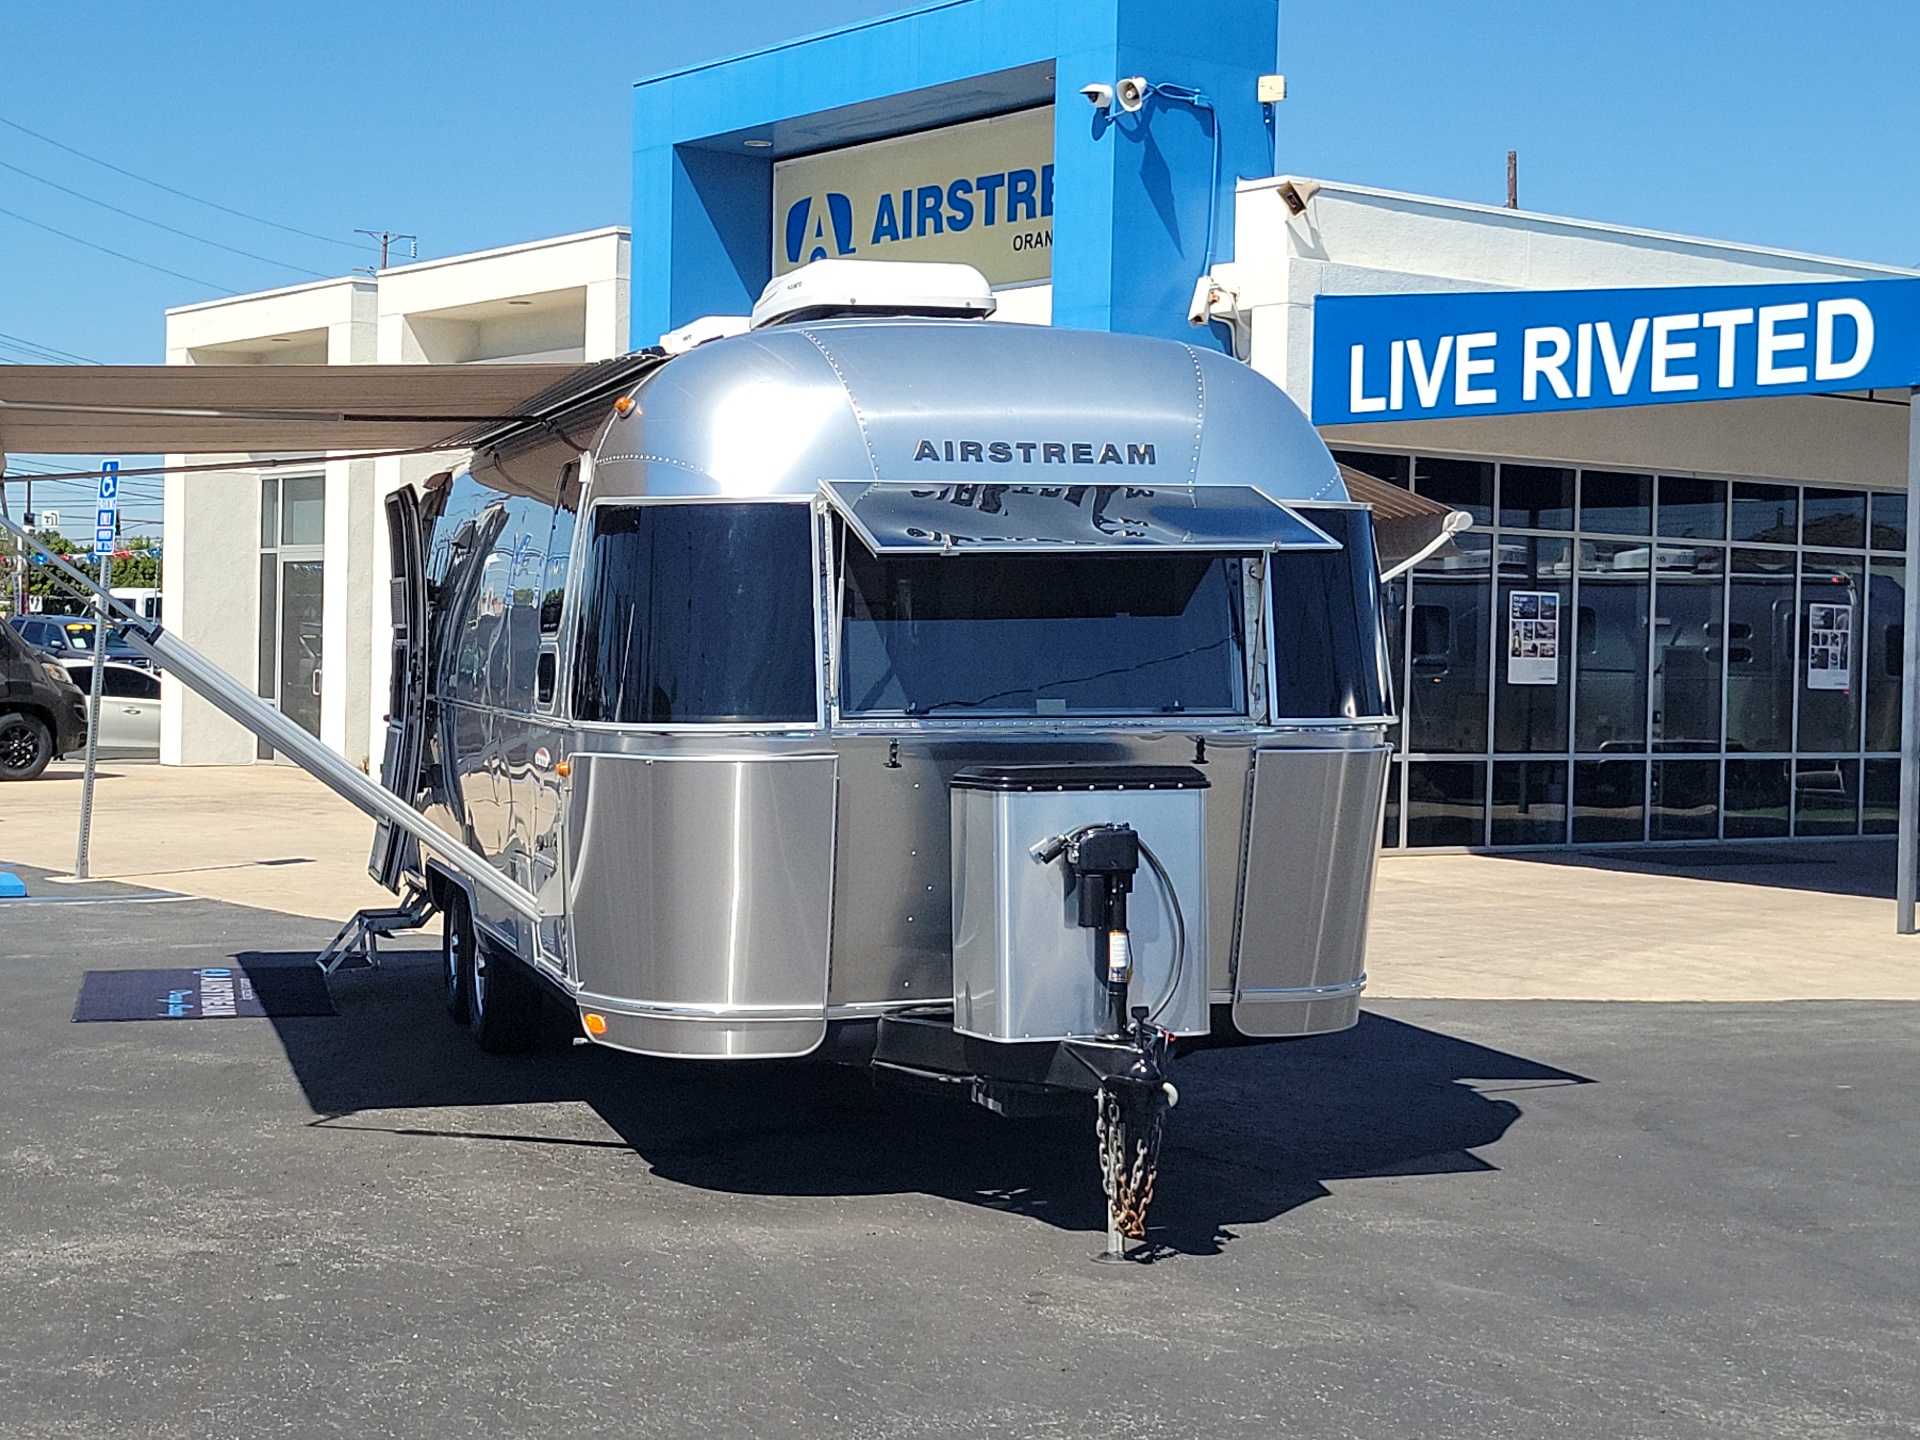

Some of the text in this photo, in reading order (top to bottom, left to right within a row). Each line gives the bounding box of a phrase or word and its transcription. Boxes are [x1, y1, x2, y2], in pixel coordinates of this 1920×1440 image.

[1013, 230, 1054, 251] ORAN
[1350, 298, 1875, 413] LIVE RIVETED
[913, 439, 1157, 465] AIRSTREAM
